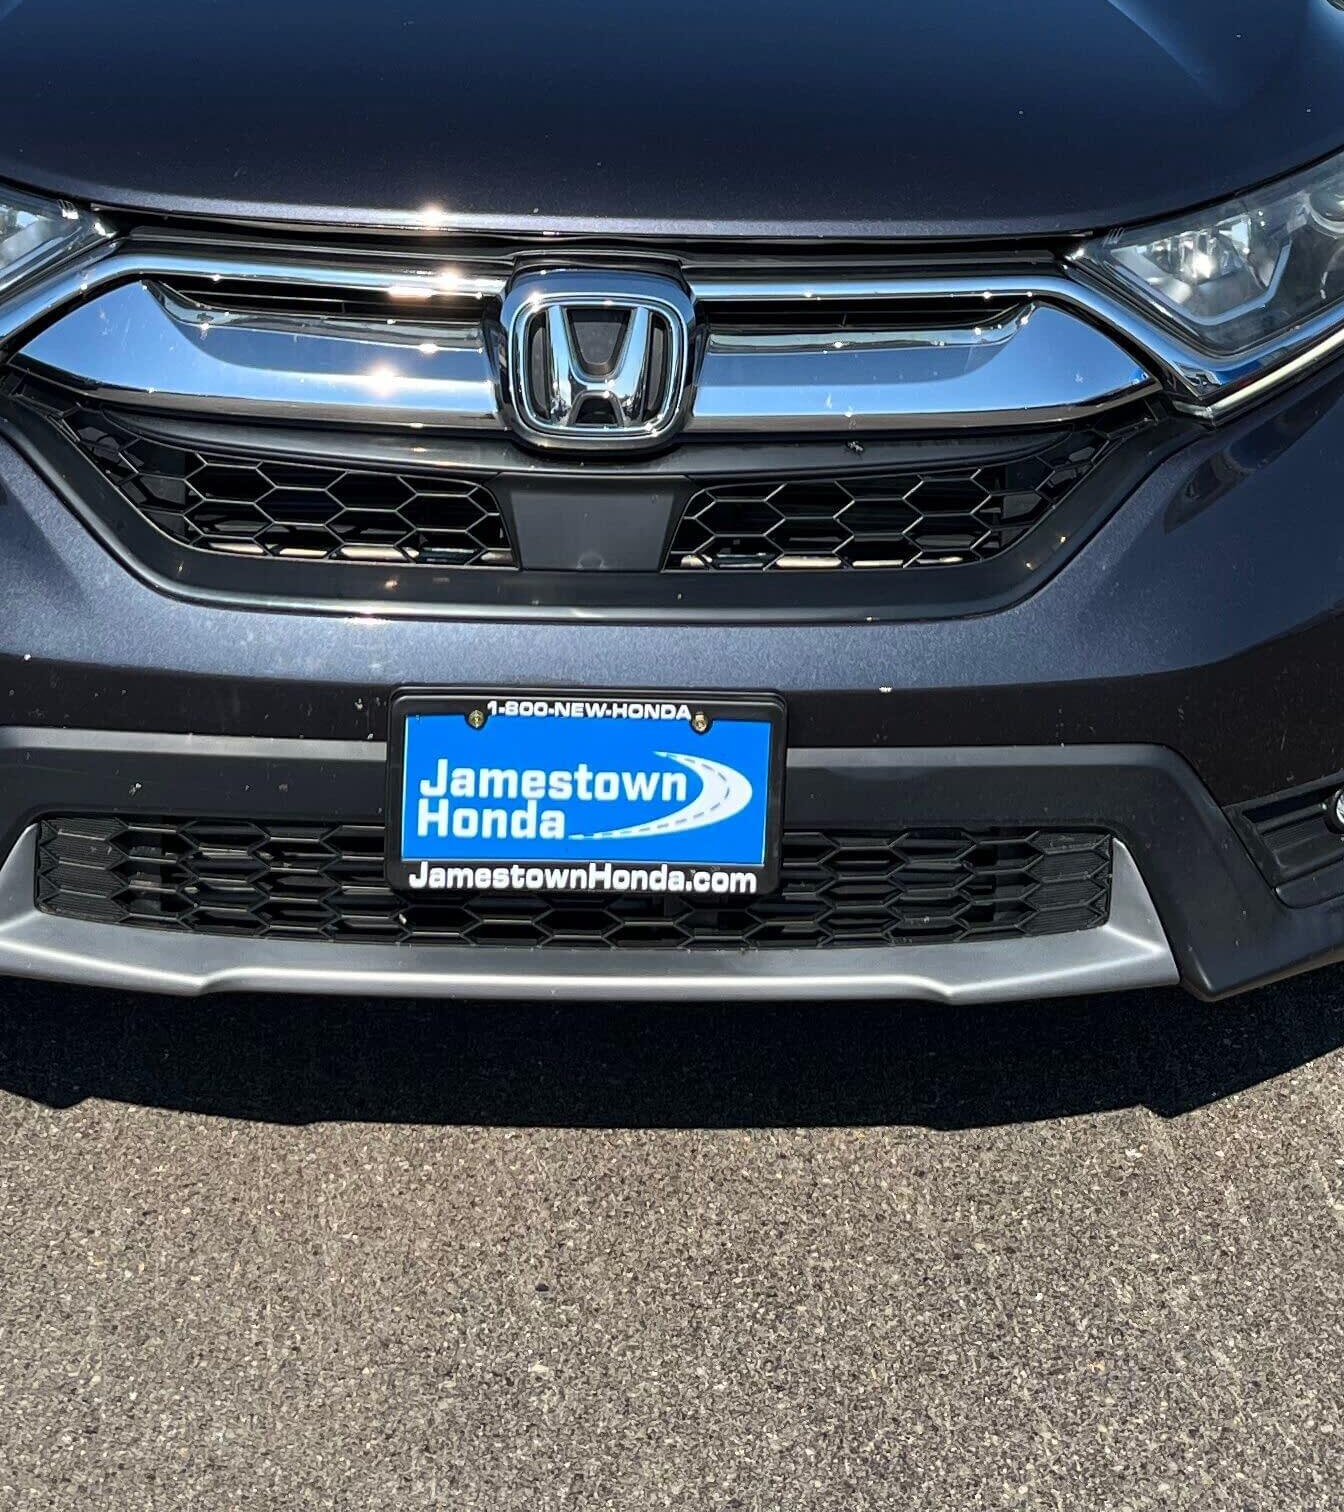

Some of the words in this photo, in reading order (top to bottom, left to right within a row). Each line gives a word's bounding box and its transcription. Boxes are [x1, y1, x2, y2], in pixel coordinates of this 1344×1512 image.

[487, 700, 692, 720] 1-800-NEW-HONDA
[420, 758, 687, 801] Jamestown
[417, 798, 565, 839] Honda
[409, 861, 757, 893] JamestownHonda.com
